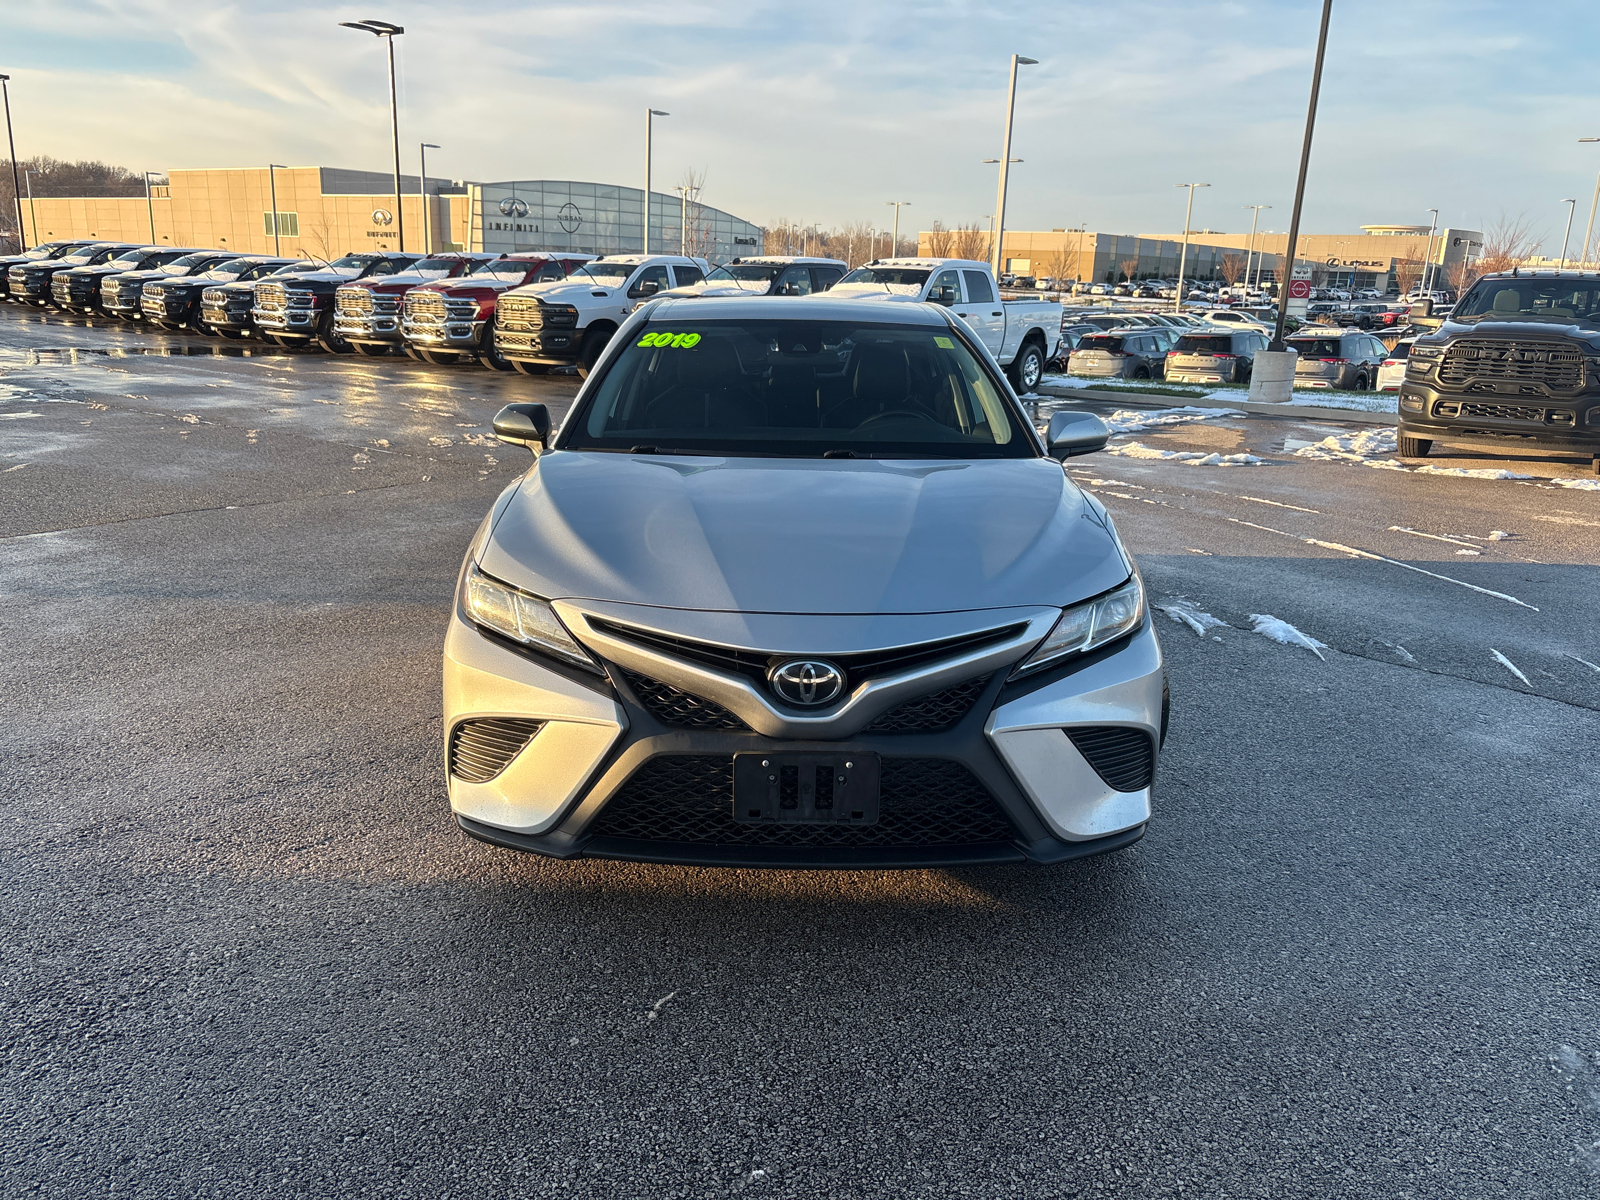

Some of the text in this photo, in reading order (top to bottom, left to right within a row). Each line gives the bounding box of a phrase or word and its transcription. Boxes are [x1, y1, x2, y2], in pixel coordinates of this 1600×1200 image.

[556, 214, 583, 222] NISSAN
[488, 222, 539, 233] INFINITI
[503, 303, 528, 312] RAM
[637, 332, 701, 349] 2019
[1479, 349, 1548, 362] RAM
